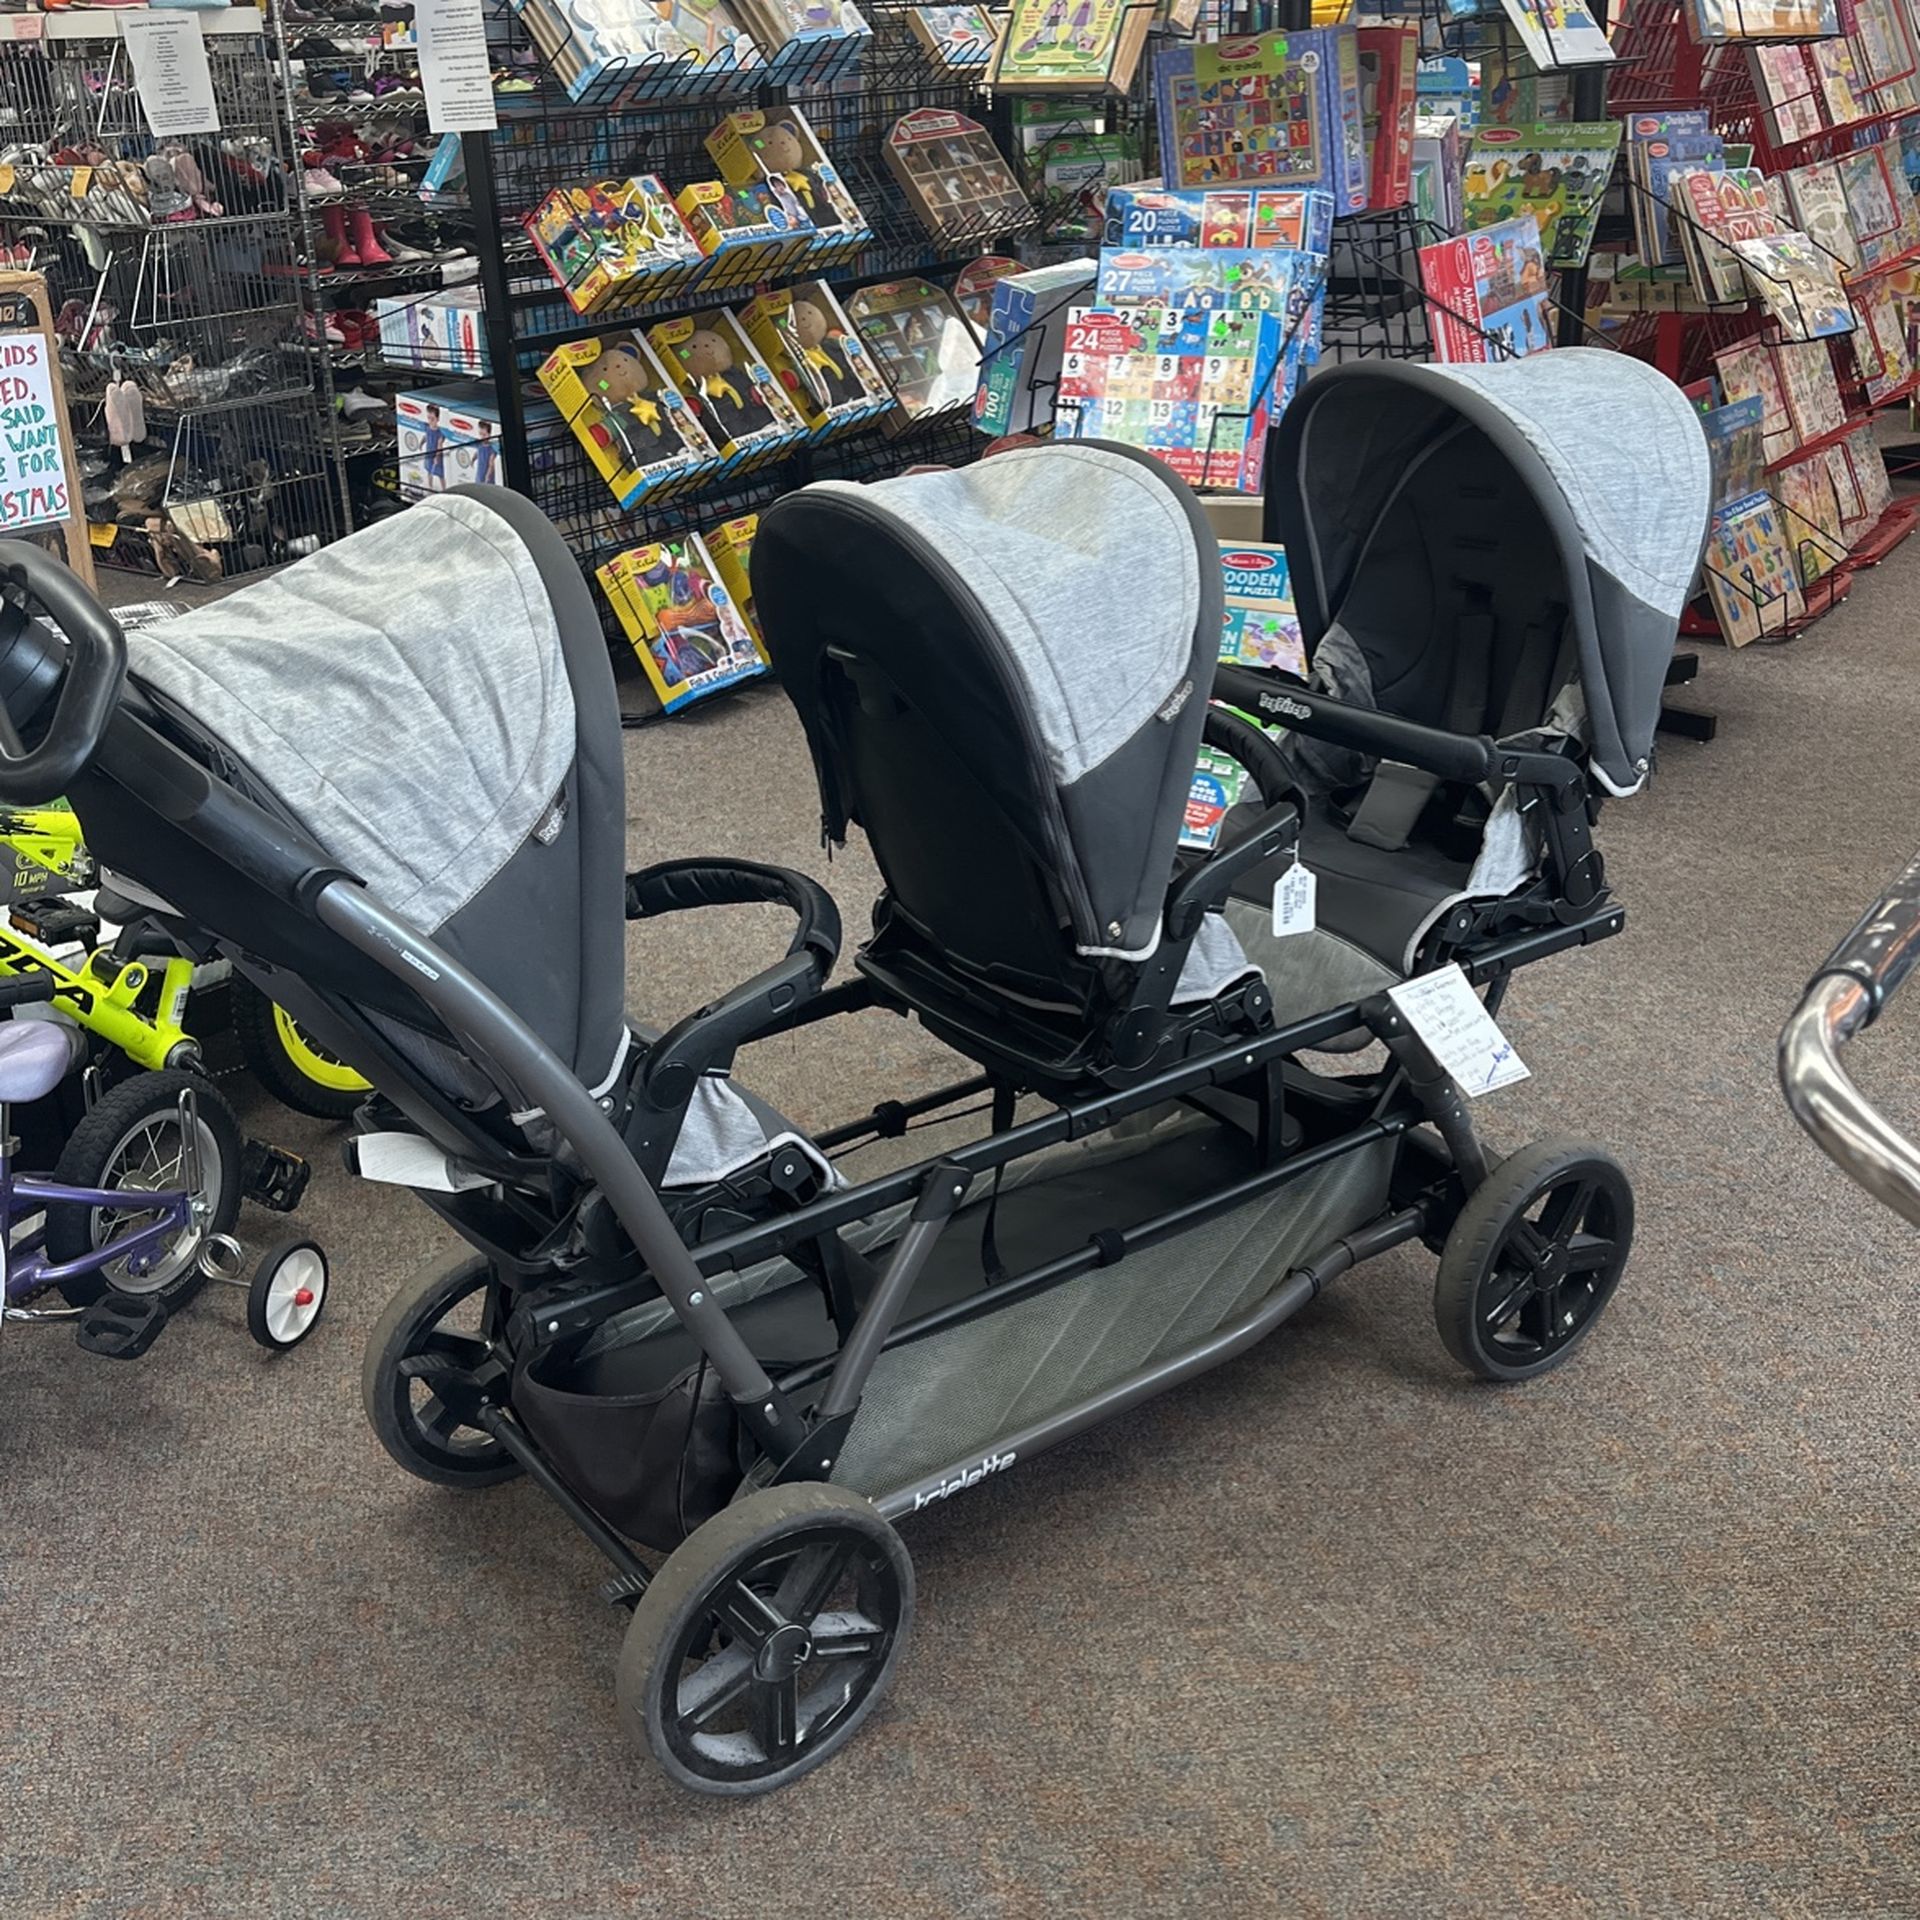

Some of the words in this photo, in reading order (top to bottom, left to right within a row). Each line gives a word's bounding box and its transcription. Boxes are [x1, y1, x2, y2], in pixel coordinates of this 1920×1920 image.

[1129, 211, 1157, 232] 20
[1103, 271, 1132, 292] 27
[1074, 310, 1082, 324] 1
[1119, 311, 1129, 325] 2
[1167, 311, 1178, 326] 3
[1070, 328, 1099, 350] 24
[1068, 354, 1079, 370] 6
[1114, 356, 1125, 371] 7
[1161, 357, 1172, 373] 8
[1210, 359, 1221, 374] 9
[984, 390, 1000, 419] 100
[1106, 400, 1123, 416] 12
[1152, 402, 1170, 418] 13
[1201, 404, 1219, 419] 14
[1, 404, 45, 430] SAID
[6, 424, 58, 454] WANT
[18, 449, 60, 479] FOR
[1164, 454, 1192, 466] Farm
[1194, 455, 1237, 468] Nmber
[1223, 570, 1283, 588] OODEN
[1243, 586, 1280, 597] PUZZLE
[1191, 784, 1218, 796] OOSE
[13, 871, 29, 887] 10
[29, 872, 48, 884] MPH
[913, 1451, 1017, 1512] triplette
